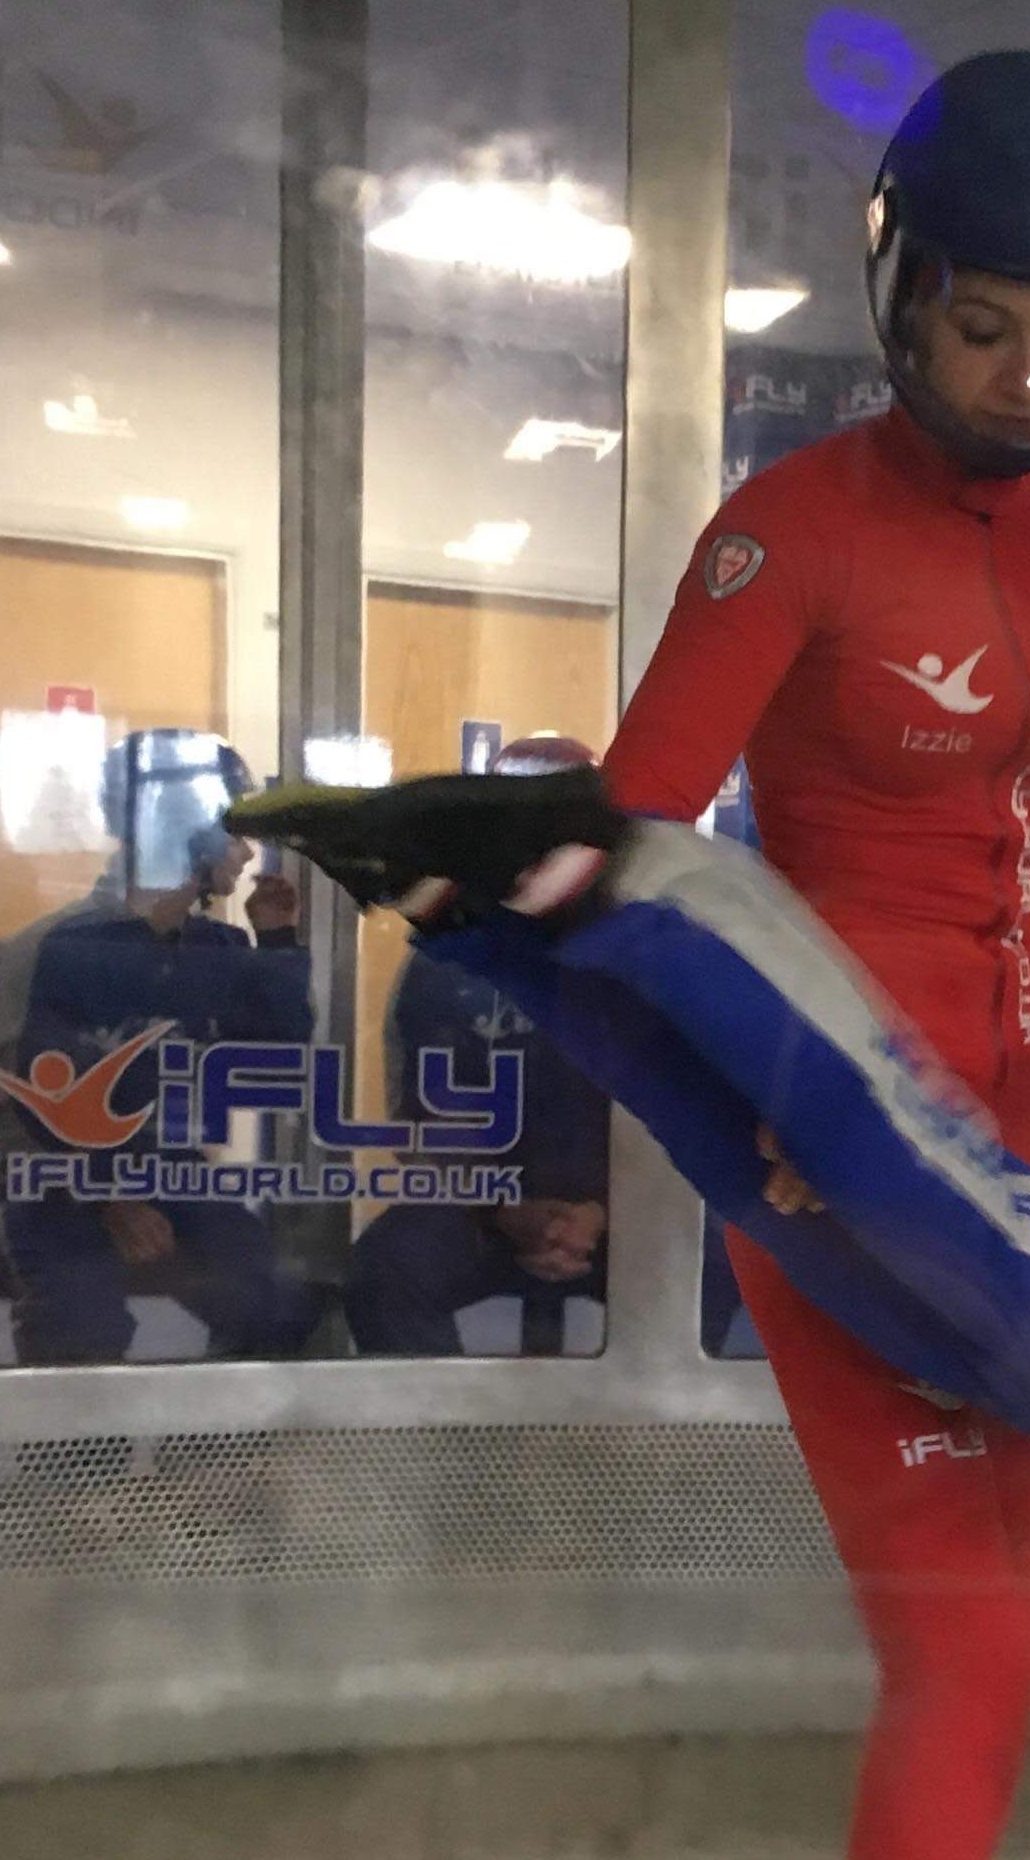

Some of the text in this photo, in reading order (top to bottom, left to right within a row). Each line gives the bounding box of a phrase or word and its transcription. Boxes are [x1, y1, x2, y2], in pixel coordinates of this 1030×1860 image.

[902, 725, 972, 753] Izzie
[158, 1039, 524, 1154] iFLY
[6, 1153, 524, 1205] iFLYWORLD.CO.UK
